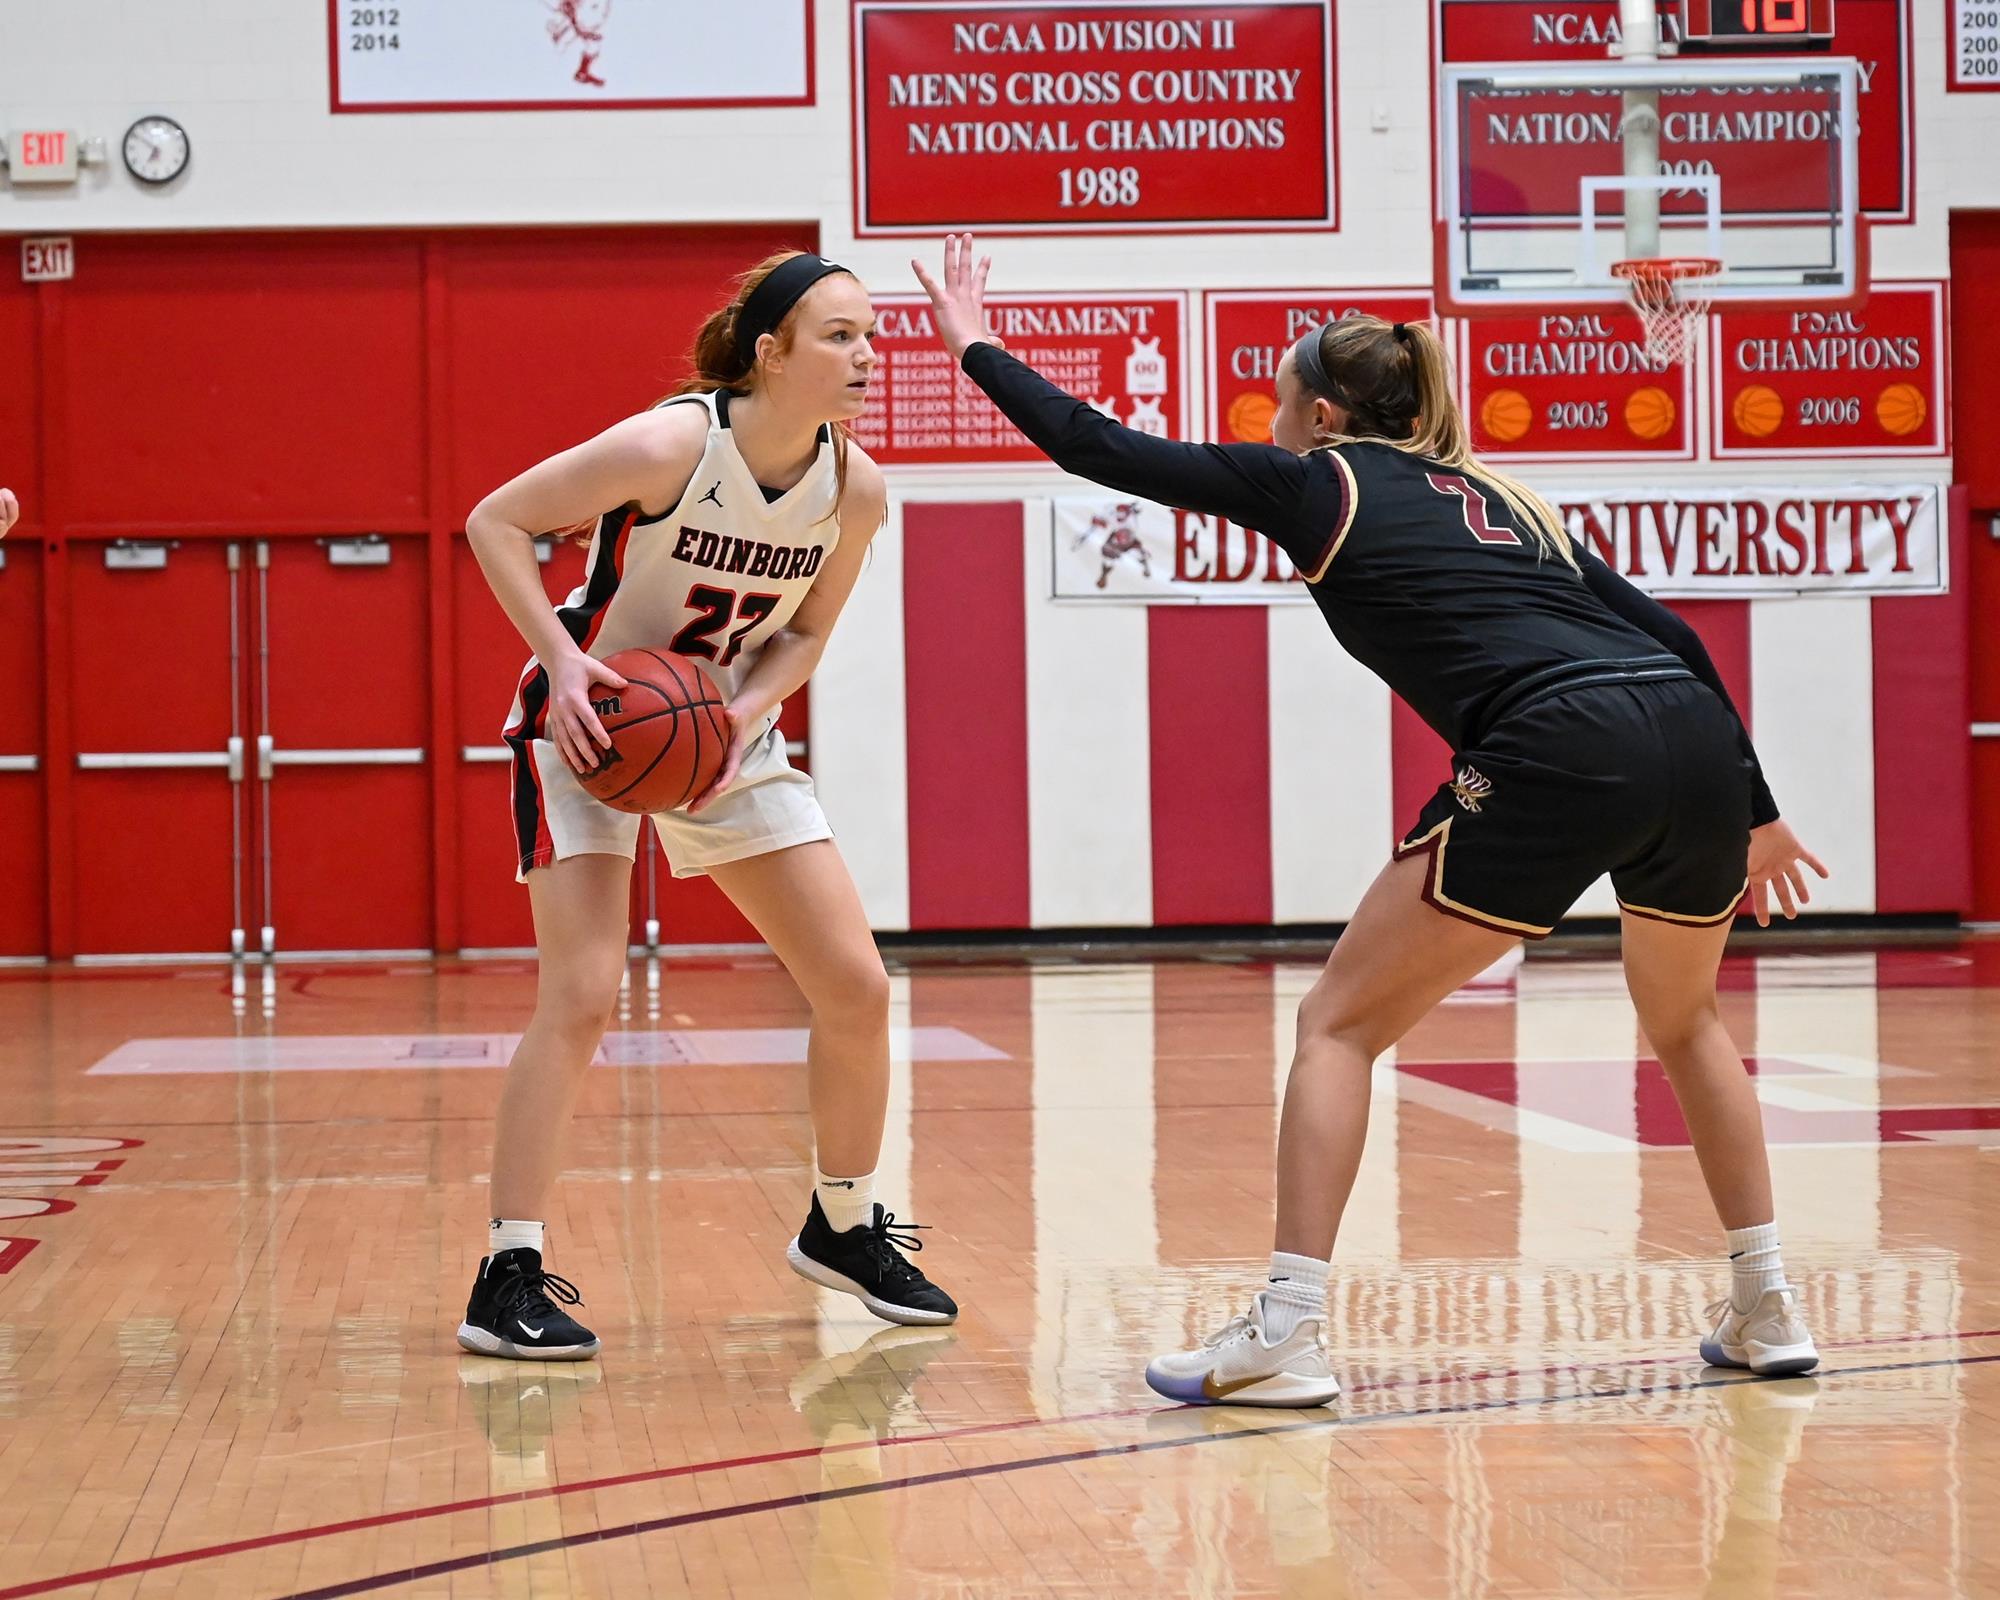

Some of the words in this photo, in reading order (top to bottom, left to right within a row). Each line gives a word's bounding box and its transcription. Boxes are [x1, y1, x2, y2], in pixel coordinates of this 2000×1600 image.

[350, 9, 399, 26] 2012
[1532, 14, 1623, 44] NCAA
[1963, 12, 2000, 28] 200
[351, 34, 399, 50] 2014
[953, 22, 1046, 52] NCAA
[1054, 20, 1202, 51] DIVISION
[1211, 20, 1236, 49] II
[1963, 36, 2000, 53] 200
[1963, 59, 2000, 75] 200
[888, 73, 998, 106] MEN'S
[1005, 71, 1121, 104] CROSS
[1128, 69, 1301, 103] COUNTRY
[907, 121, 1079, 153] NATIONAL
[1085, 118, 1286, 151] CHAMPIONS
[1487, 112, 1626, 145] NATION
[1664, 110, 1860, 143] CHAMPION
[22, 131, 67, 166] EXIT
[1058, 166, 1140, 207] 1988
[1657, 160, 1715, 199] 990
[26, 243, 69, 274] EXIT
[874, 307, 934, 339] CAA
[985, 305, 1154, 337] URNAMENT
[1484, 340, 1669, 376] CHAMPIONS
[1737, 336, 1921, 372] CHAMPIONS
[1547, 400, 1609, 430] 2005
[1799, 396, 1861, 426] 2006
[1425, 472, 1522, 546] 2
[671, 526, 824, 580] EDINBORO
[1559, 498, 1924, 576] NIVERSITY
